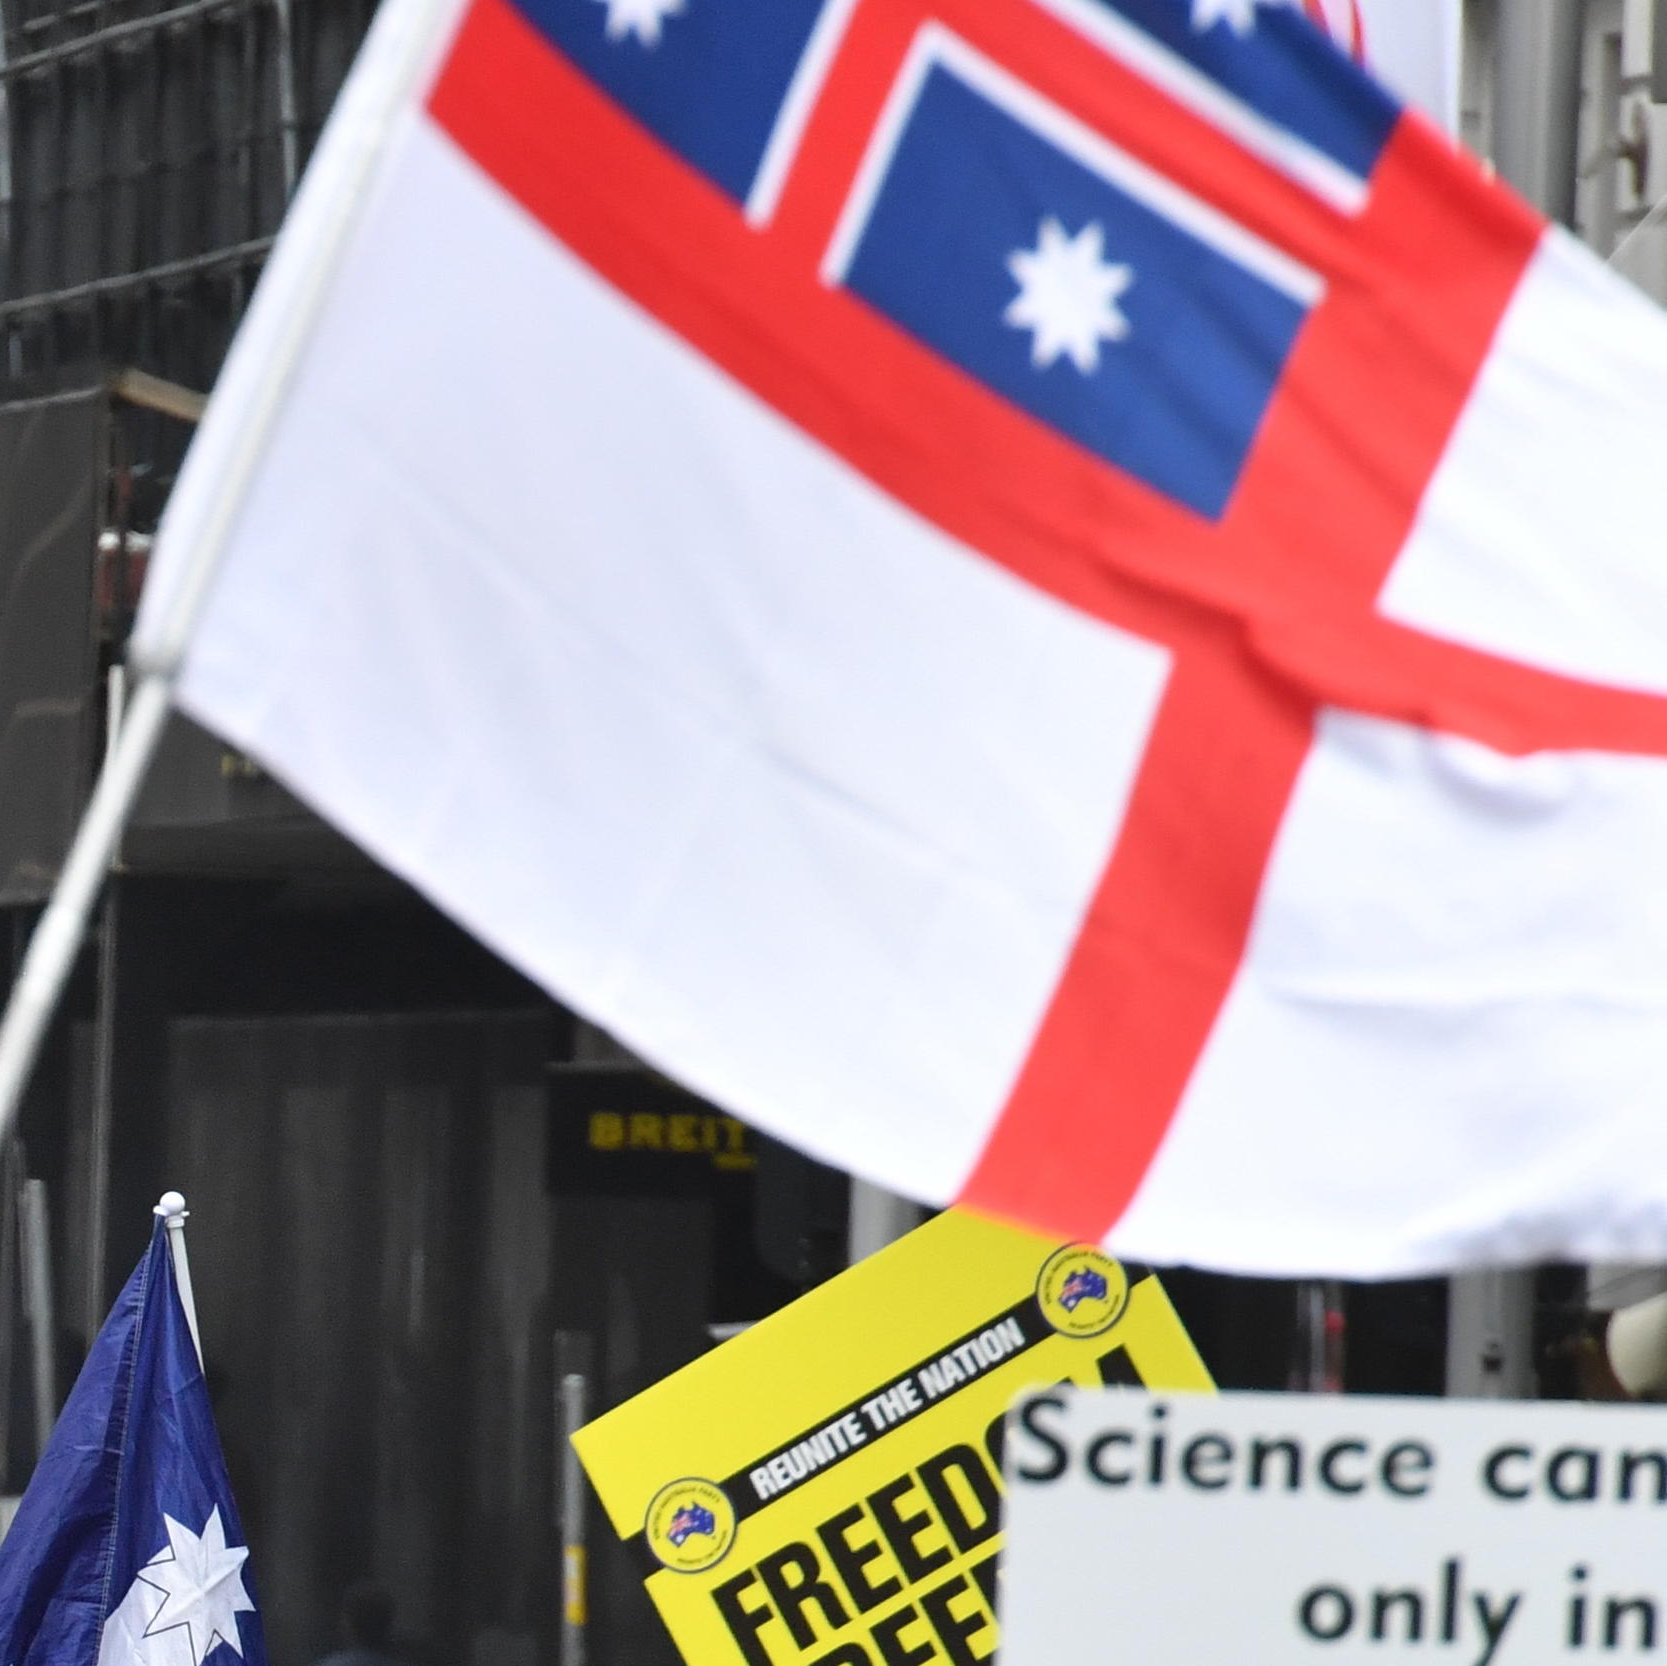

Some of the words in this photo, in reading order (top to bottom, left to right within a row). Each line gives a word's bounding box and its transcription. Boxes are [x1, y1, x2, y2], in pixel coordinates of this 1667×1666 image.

[588, 1112, 747, 1152] BREIT
[749, 1411, 867, 1501] REUNITE
[861, 1377, 924, 1432] THE
[917, 1316, 1026, 1399] NATION
[1014, 1392, 1437, 1499] Science
[1481, 1440, 1667, 1502] can
[1566, 1565, 1658, 1651] in
